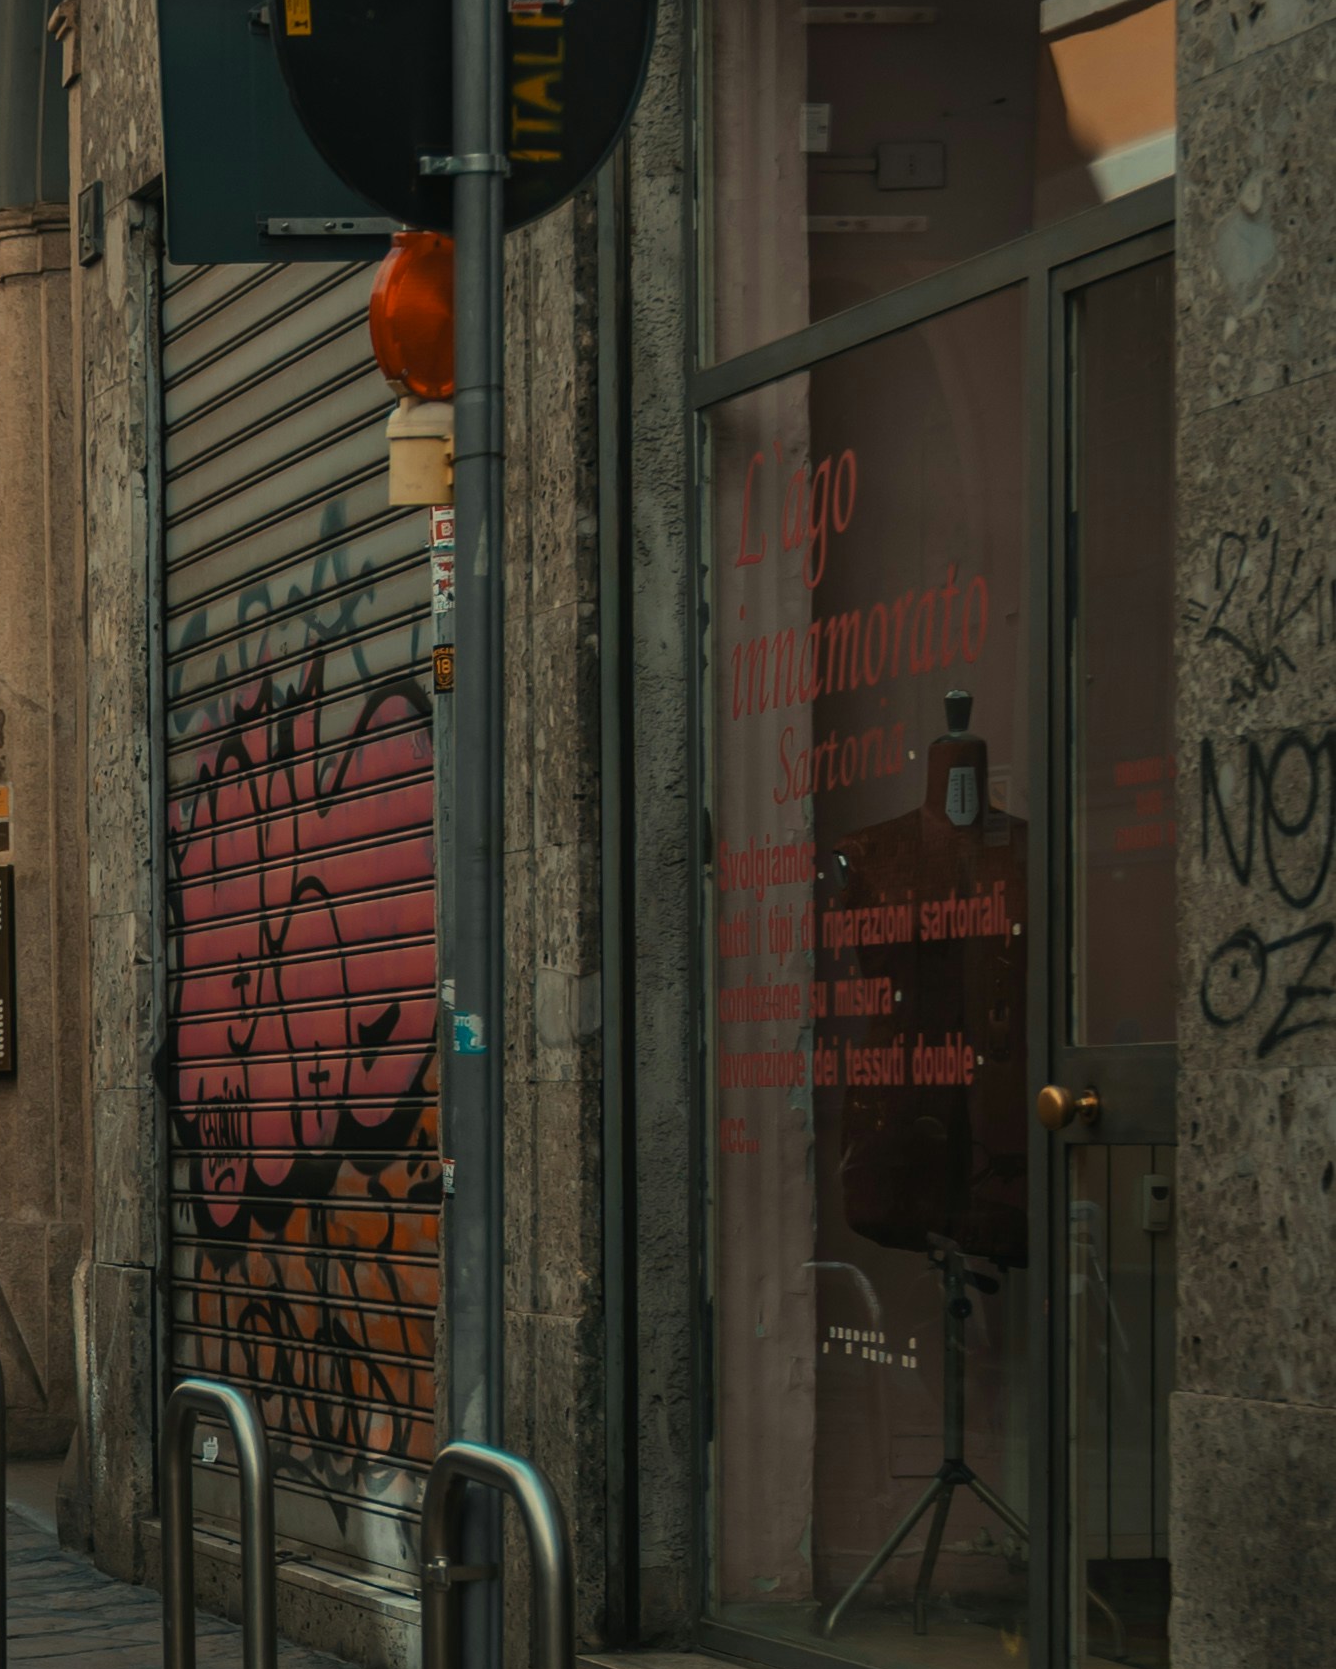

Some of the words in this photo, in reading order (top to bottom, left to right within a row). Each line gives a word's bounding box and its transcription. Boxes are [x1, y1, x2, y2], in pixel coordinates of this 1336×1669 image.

[731, 561, 989, 722] innamorato
[773, 696, 906, 805] Sartoria
[719, 833, 817, 903] Svolgiamo:
[719, 905, 750, 959] tutti
[756, 906, 763, 956] i
[767, 902, 794, 967] tipi
[800, 900, 817, 953] di
[822, 889, 914, 962] riparazioni
[919, 880, 1011, 950] sartoriali,
[719, 973, 802, 1023] confezione
[808, 980, 828, 1019] su
[833, 965, 894, 1018] misura
[719, 1039, 807, 1090] lavorazione
[814, 1023, 840, 1087] dei
[845, 1022, 906, 1087] tessuti
[911, 1032, 976, 1087] double
